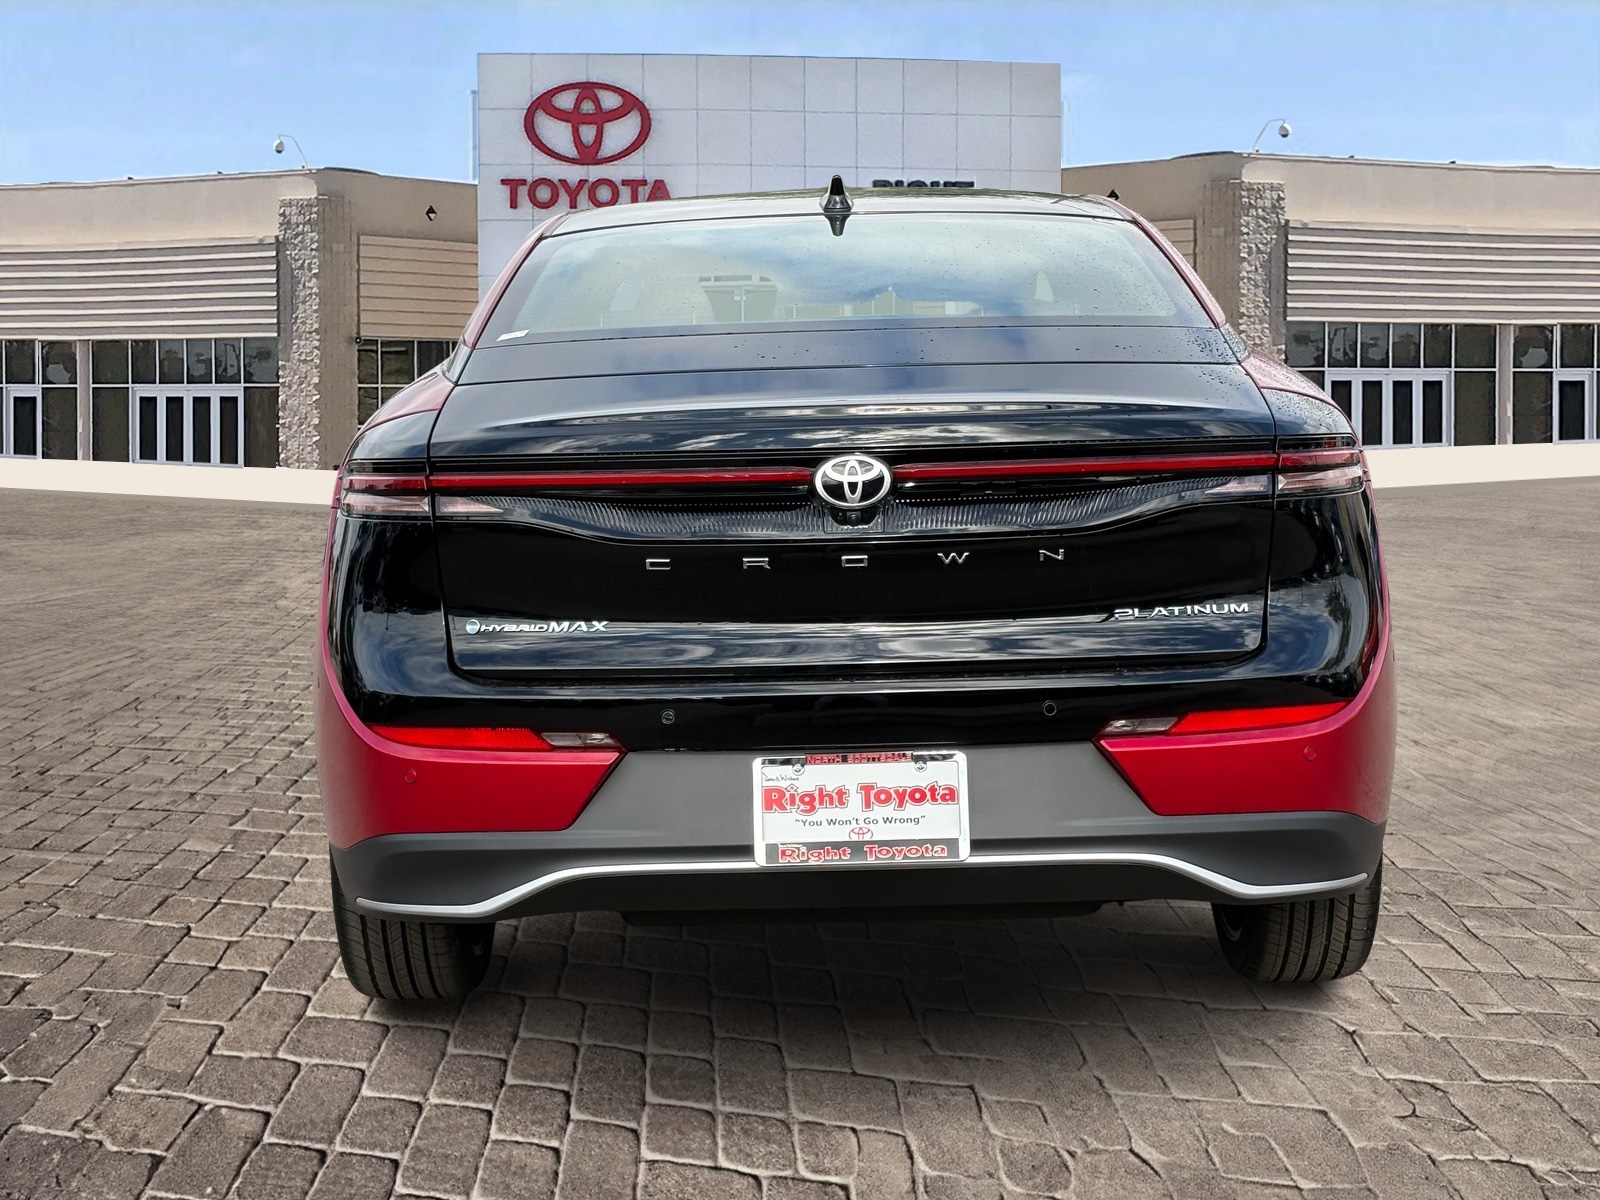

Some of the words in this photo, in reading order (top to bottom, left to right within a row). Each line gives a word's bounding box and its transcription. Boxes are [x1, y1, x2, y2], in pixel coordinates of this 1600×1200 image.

[501, 178, 672, 209] TOYOTA
[646, 549, 1064, 570] CROWN
[1114, 603, 1249, 619] PLATINUM
[807, 755, 841, 763] NORTH
[847, 752, 911, 762] SCOTTSDALE
[762, 783, 849, 816] Right
[857, 781, 959, 812] Toyota
[863, 817, 879, 825] Go
[779, 847, 851, 863] Right
[864, 844, 948, 861] Toyota
